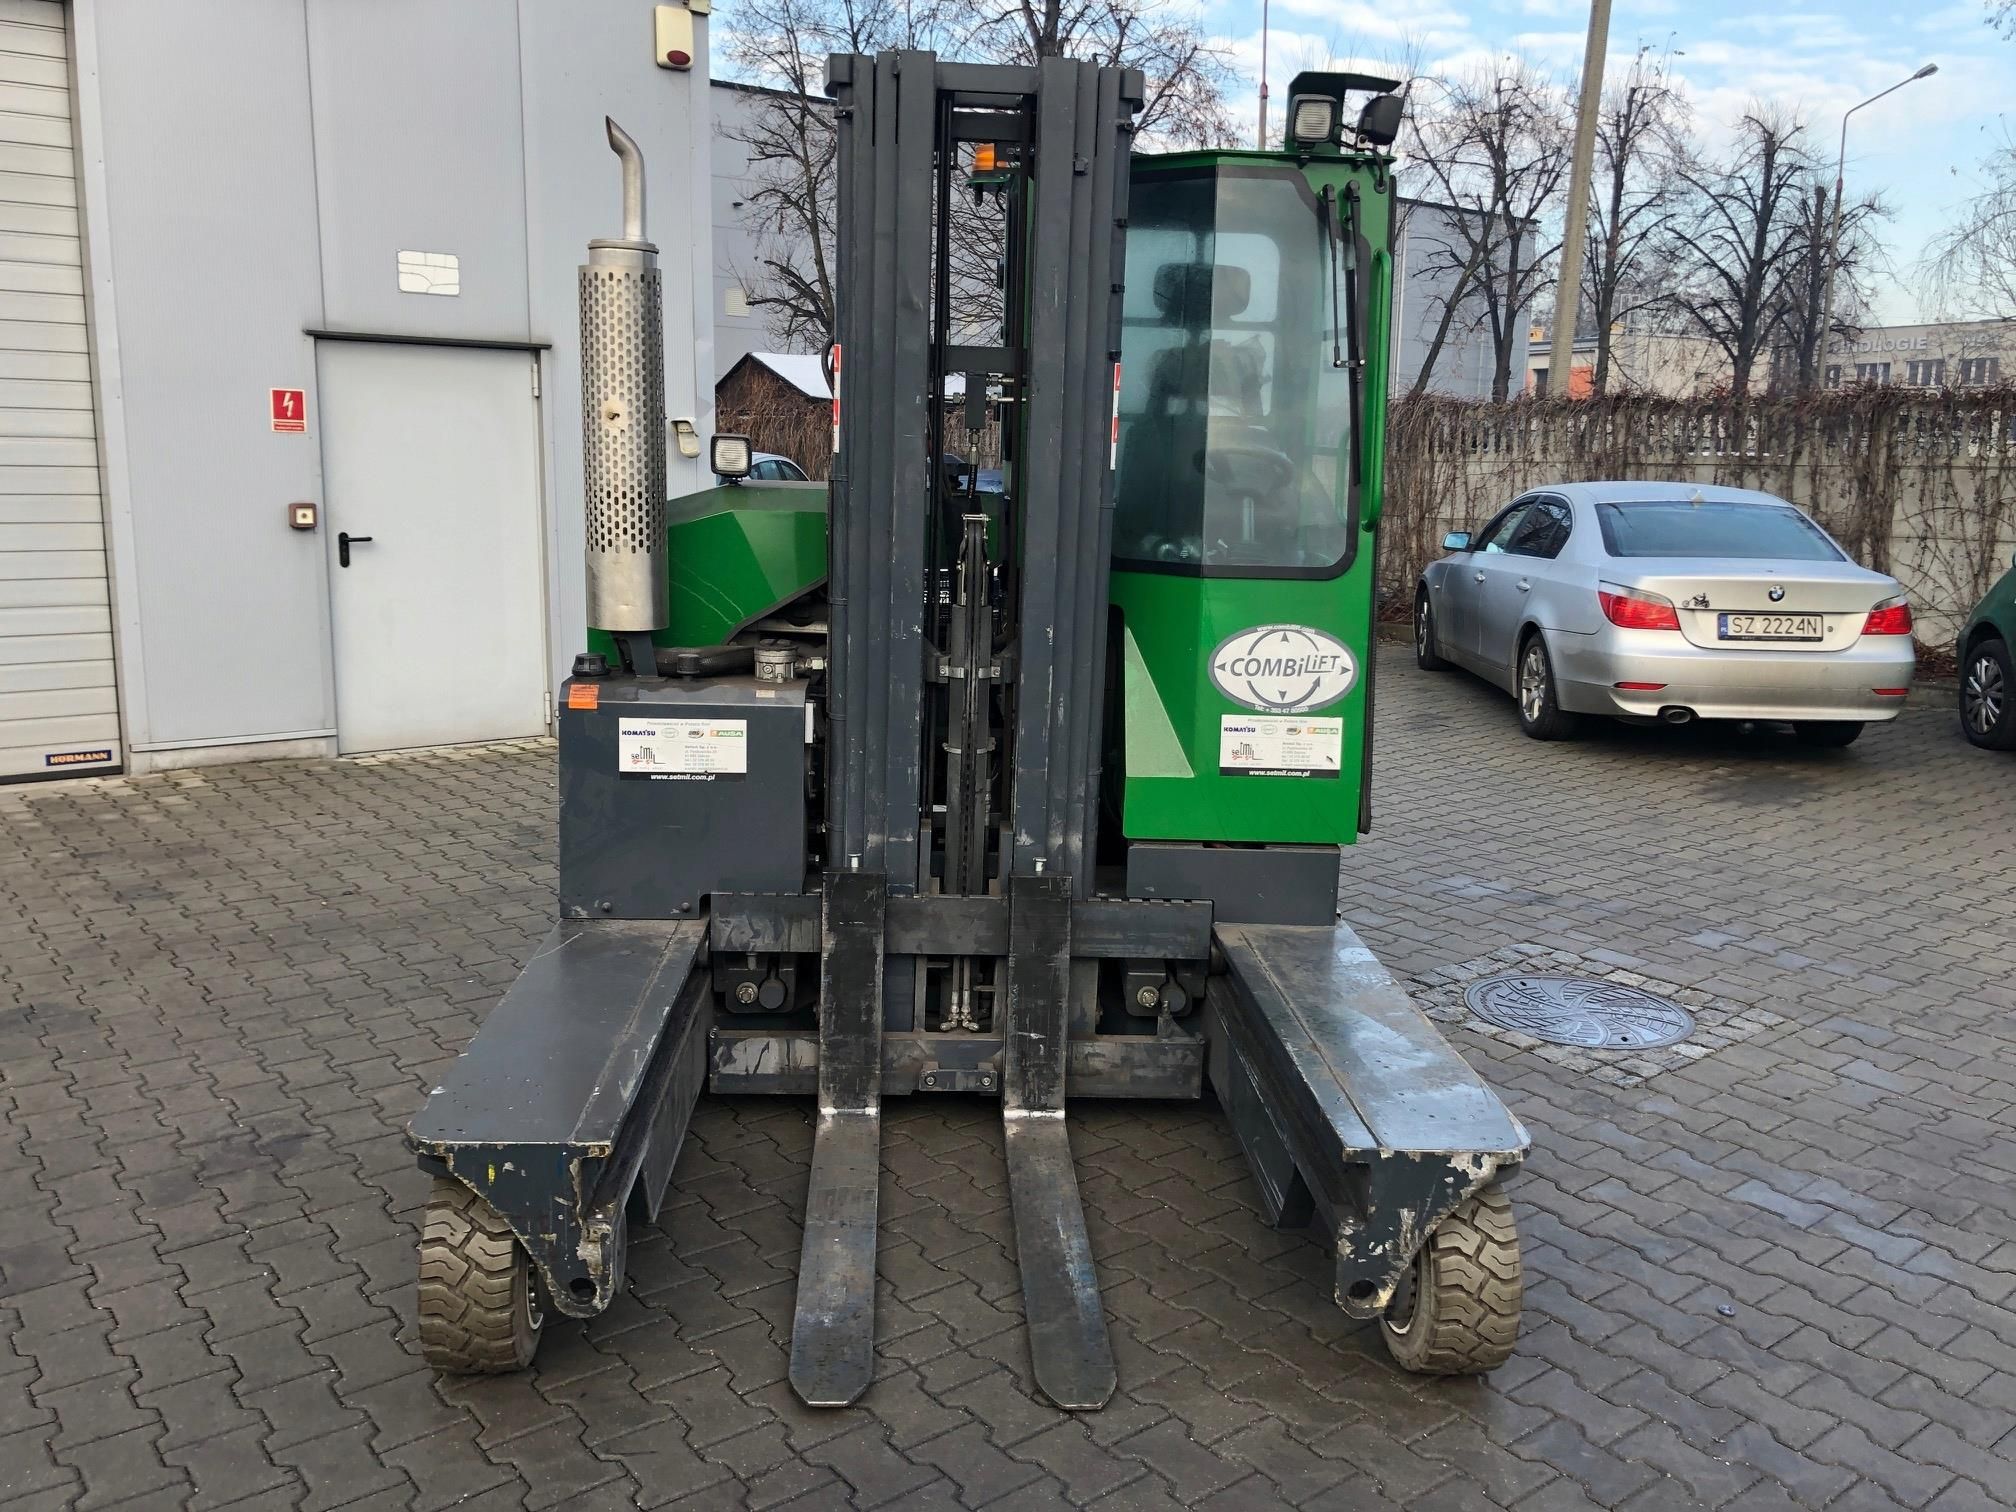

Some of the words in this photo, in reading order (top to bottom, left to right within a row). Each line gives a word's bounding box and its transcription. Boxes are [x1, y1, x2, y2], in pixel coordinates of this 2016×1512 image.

[1732, 617, 1755, 634] SZ
[1762, 617, 1817, 635] 2224N
[650, 773, 716, 782] www.setmil.com.pl
[1248, 769, 1311, 778] www.setmil.com.pl
